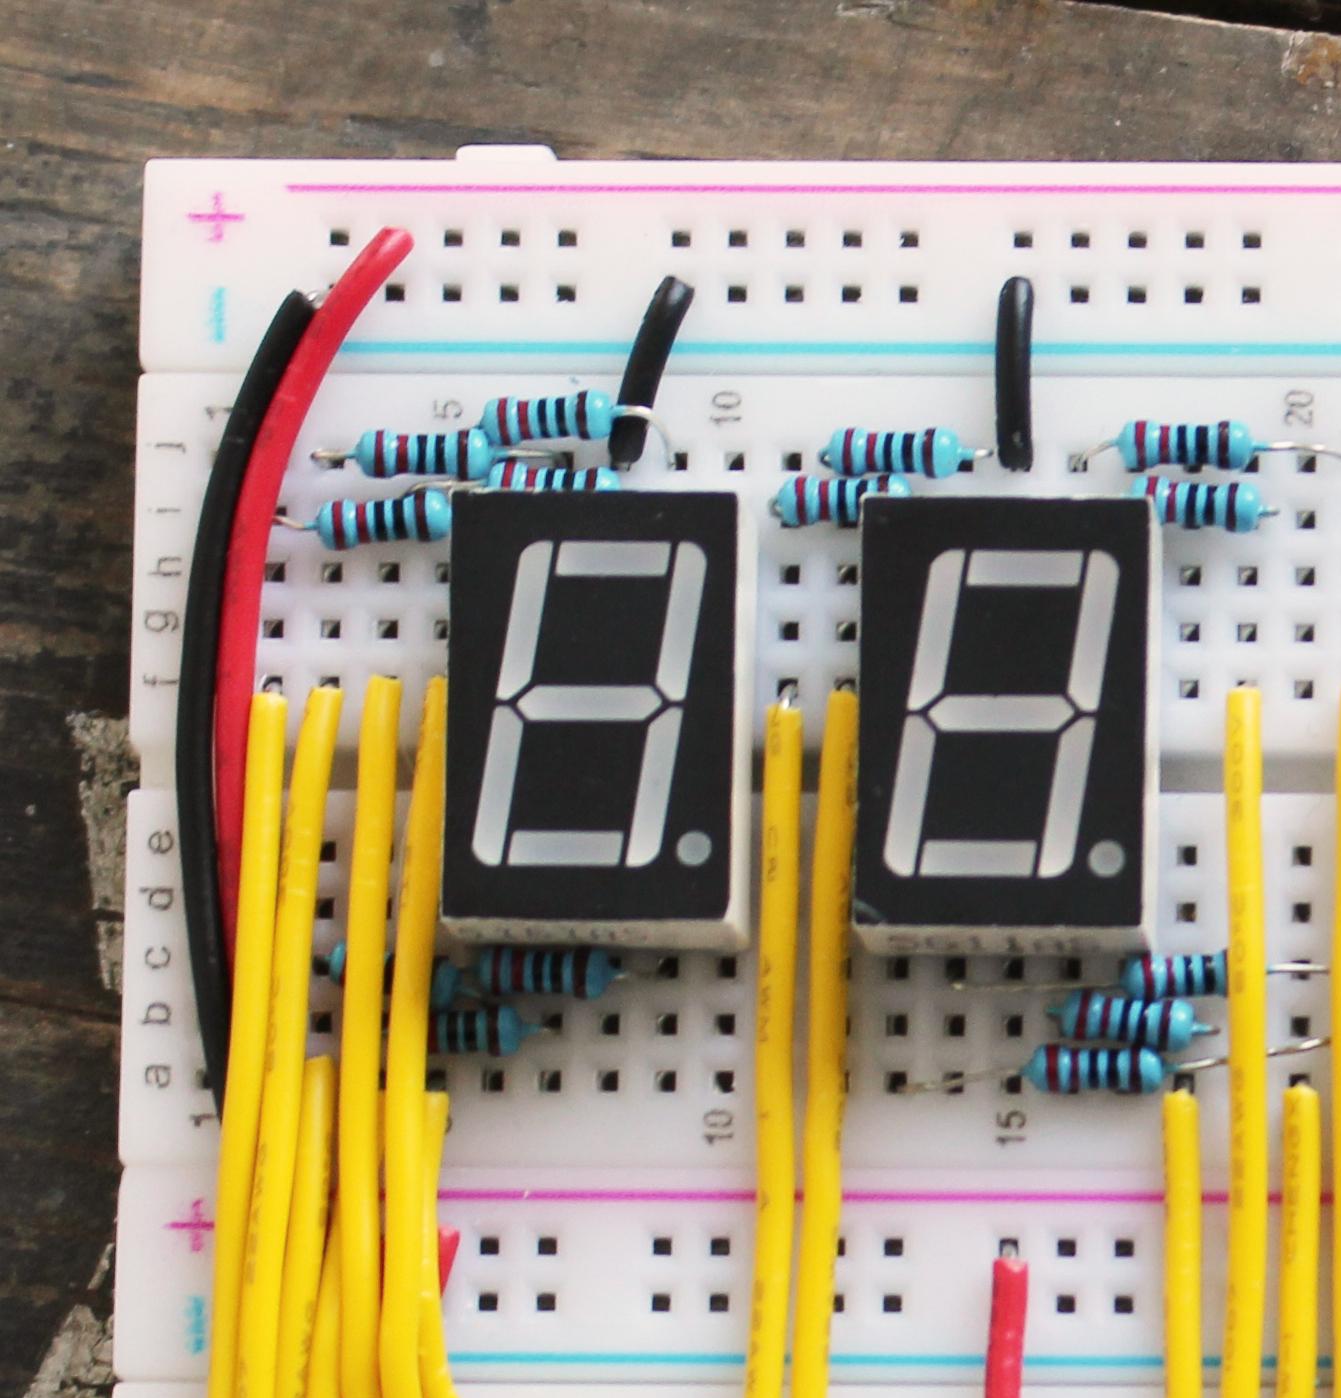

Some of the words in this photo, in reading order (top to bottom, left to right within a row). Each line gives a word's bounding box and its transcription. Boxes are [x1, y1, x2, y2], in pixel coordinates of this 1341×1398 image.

[433, 400, 464, 421] 5
[709, 390, 742, 427] 10
[1283, 389, 1314, 427] 20
[147, 555, 183, 577] h
[143, 610, 181, 634] g
[149, 828, 174, 855] e
[139, 885, 178, 912] d
[144, 945, 175, 971] c
[141, 1001, 173, 1027] b
[144, 1064, 172, 1090] a
[703, 1109, 735, 1146] 10
[995, 1107, 1028, 1145] 15
